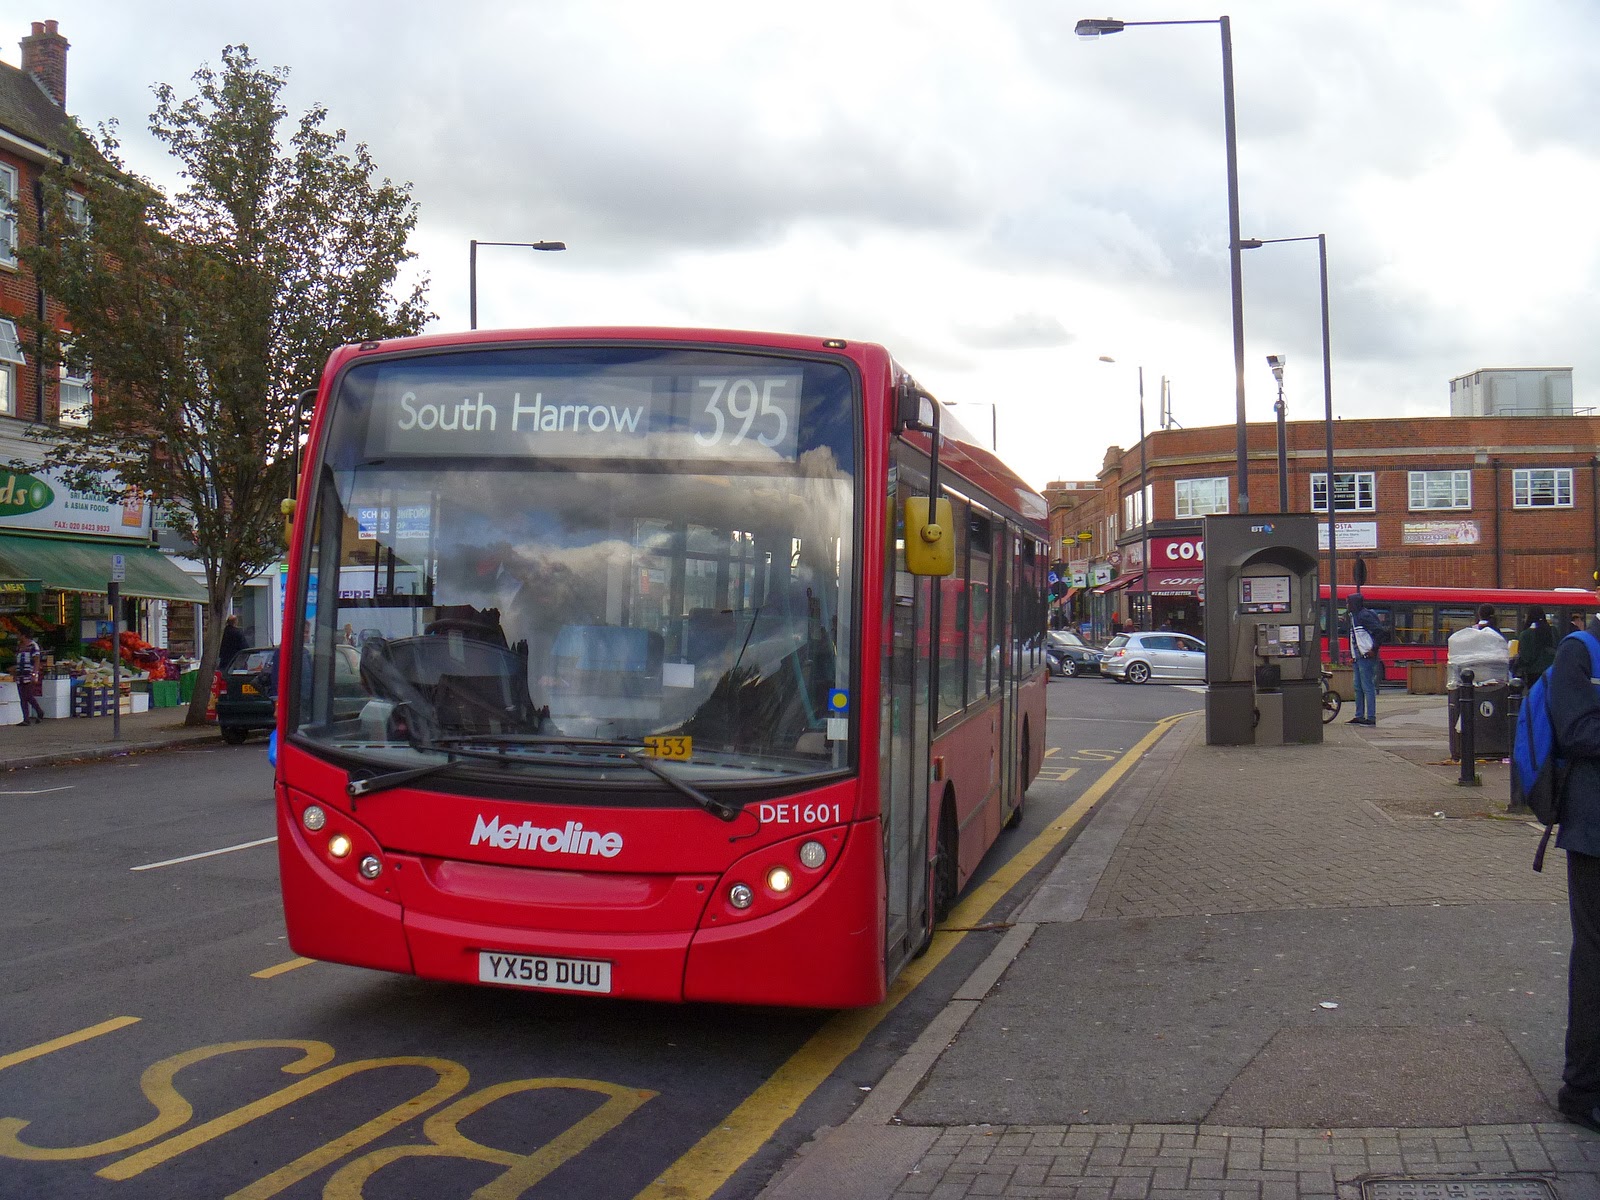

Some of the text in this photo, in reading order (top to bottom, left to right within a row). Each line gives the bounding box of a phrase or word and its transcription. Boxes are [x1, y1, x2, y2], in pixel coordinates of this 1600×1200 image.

[398, 391, 643, 433] South Harrow
[694, 378, 789, 448] 395
[70, 502, 89, 510] ASIAN
[90, 504, 109, 512] FOODS
[1166, 542, 1204, 561] COS
[651, 738, 687, 757] 153
[759, 804, 841, 824] DE1601
[470, 813, 623, 858] Metroline
[489, 955, 601, 987] YX58 DUU
